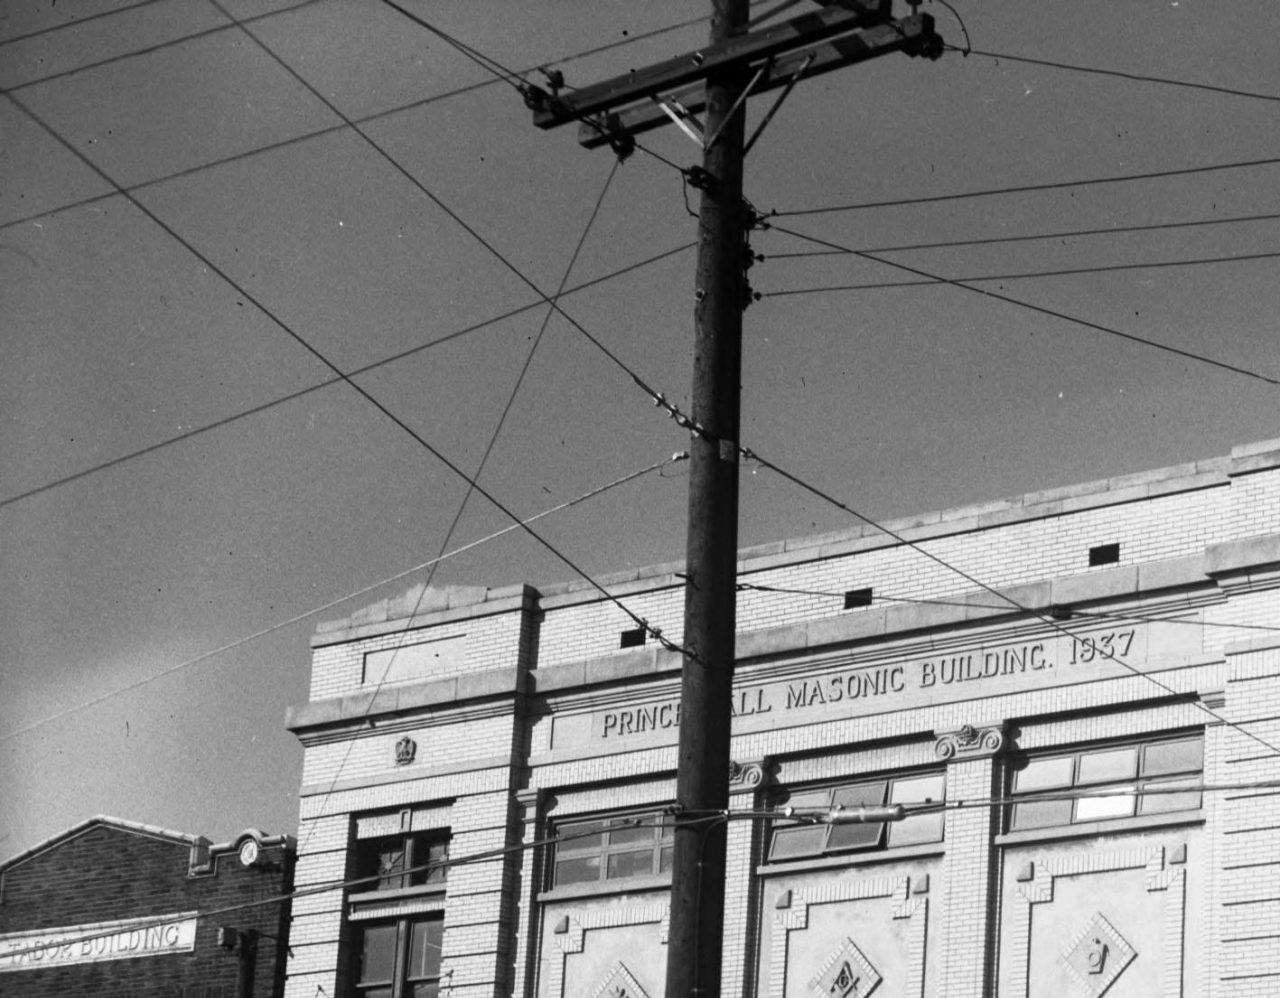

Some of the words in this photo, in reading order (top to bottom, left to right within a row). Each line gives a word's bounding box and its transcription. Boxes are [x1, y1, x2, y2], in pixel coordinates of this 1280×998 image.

[730, 689, 772, 718] LL
[785, 666, 905, 711] MASONIC
[1069, 629, 1136, 665] 1937
[81, 925, 179, 957] BUILDING
